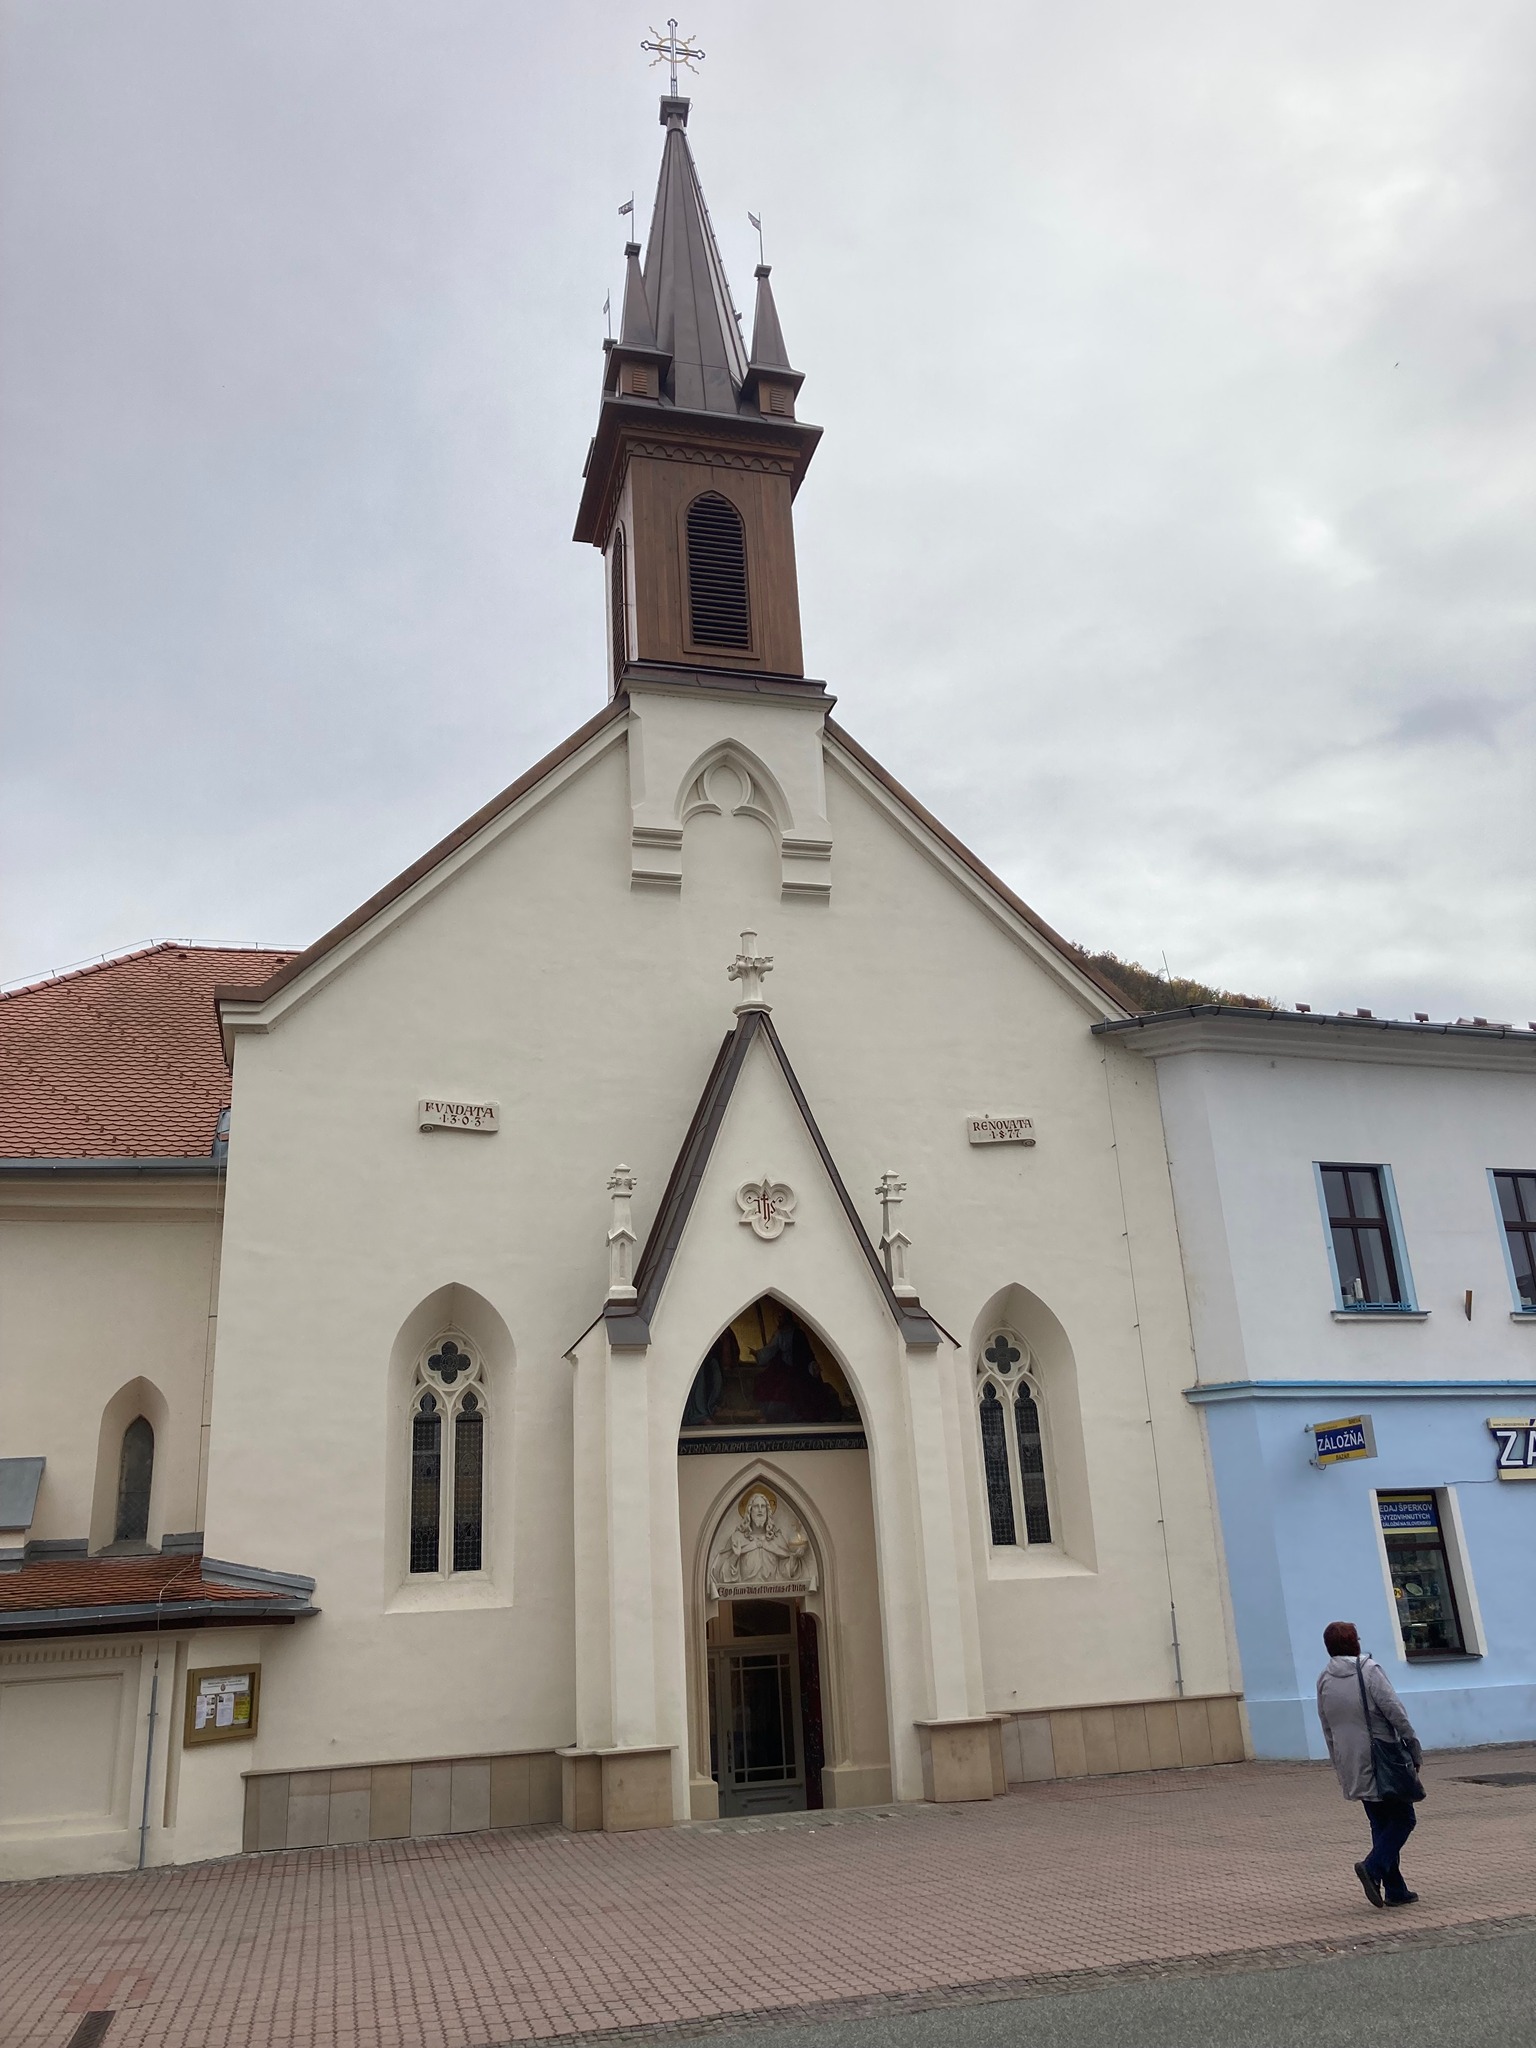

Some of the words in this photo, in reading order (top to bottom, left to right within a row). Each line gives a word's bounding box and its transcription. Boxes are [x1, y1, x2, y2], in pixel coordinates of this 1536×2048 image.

[425, 1102, 495, 1118] FVNDATA
[973, 1119, 1032, 1131] RENOVATA
[1317, 1430, 1365, 1451] ZÁLOŽŇA
[1398, 1503, 1432, 1512] ŠPERKOV
